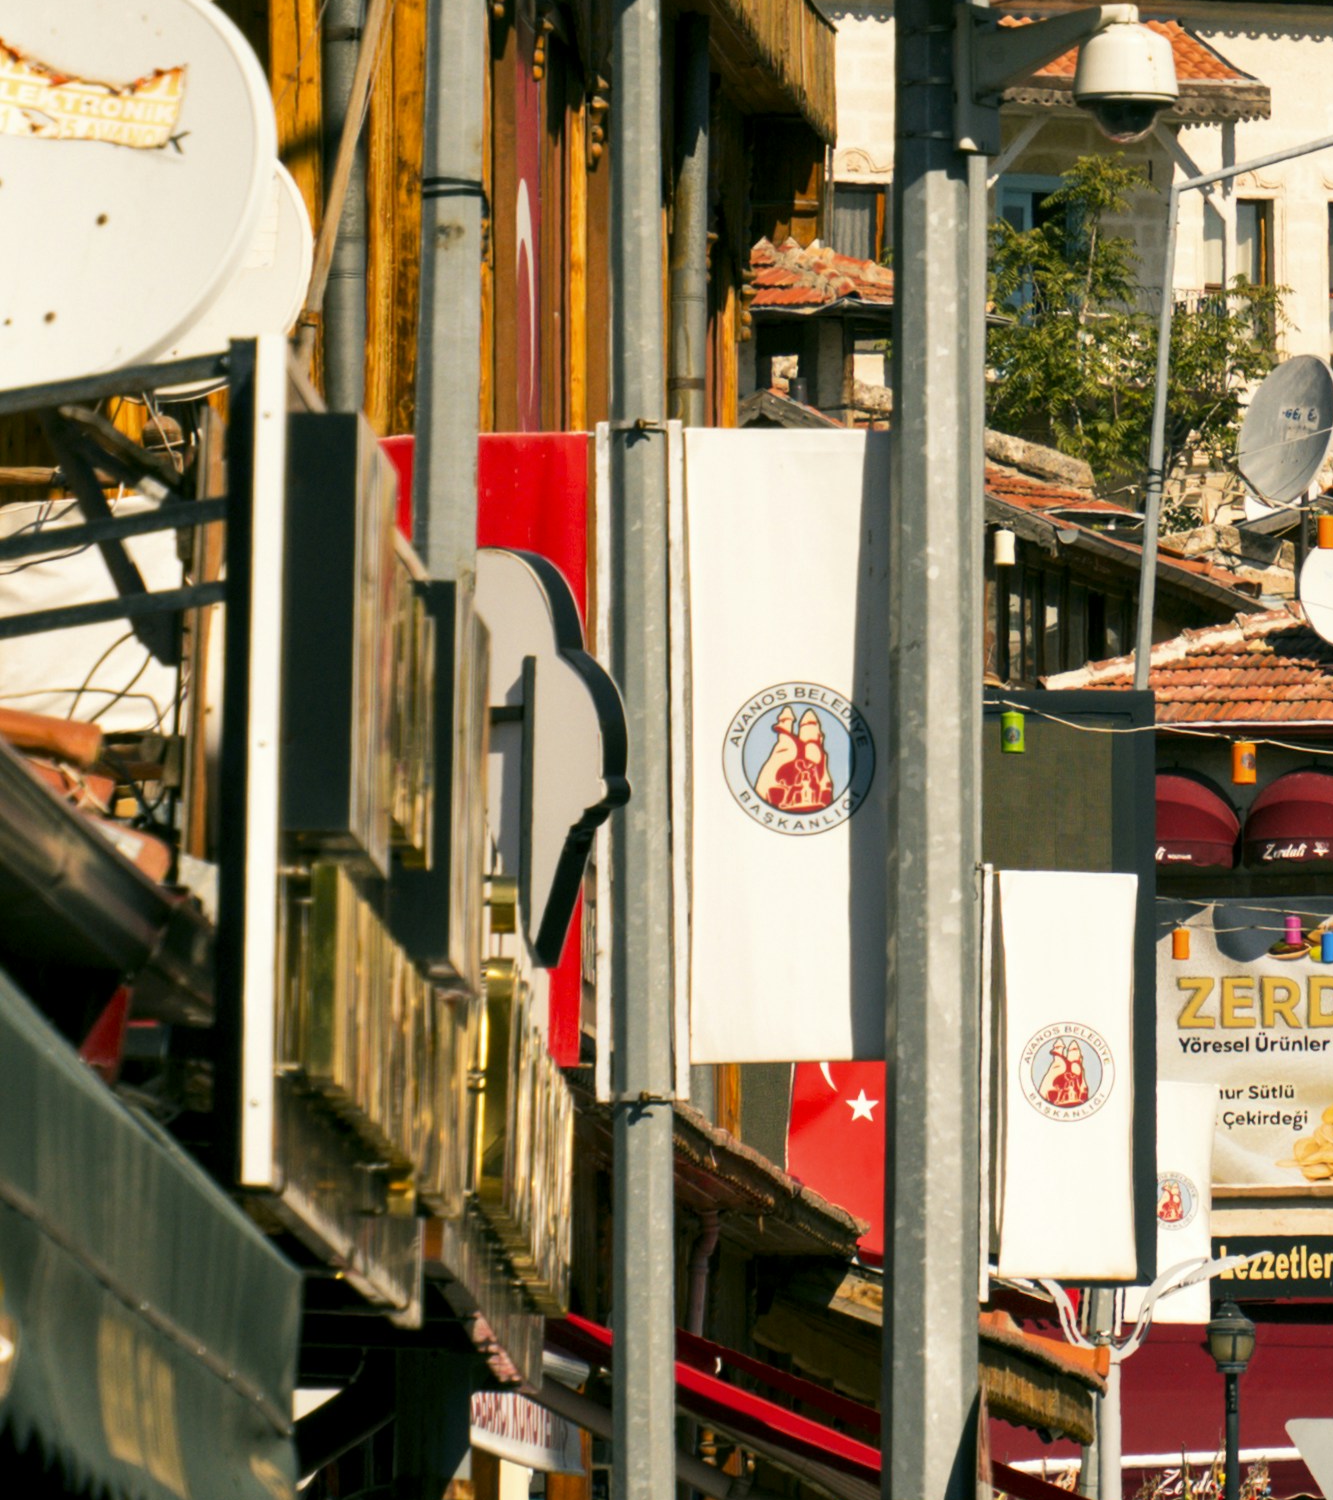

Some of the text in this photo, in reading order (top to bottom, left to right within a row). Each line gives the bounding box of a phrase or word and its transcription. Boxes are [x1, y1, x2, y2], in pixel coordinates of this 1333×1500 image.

[729, 688, 788, 747] AVANOS
[1024, 1025, 1061, 1065] AVANOS
[1178, 1036, 1250, 1054] Yöresel
[1256, 1032, 1331, 1053] Ürünler
[1249, 1085, 1295, 1100] Sütlü
[1222, 1110, 1309, 1131] Çekirdeği
[1220, 1245, 1333, 1280] Lezzetler
